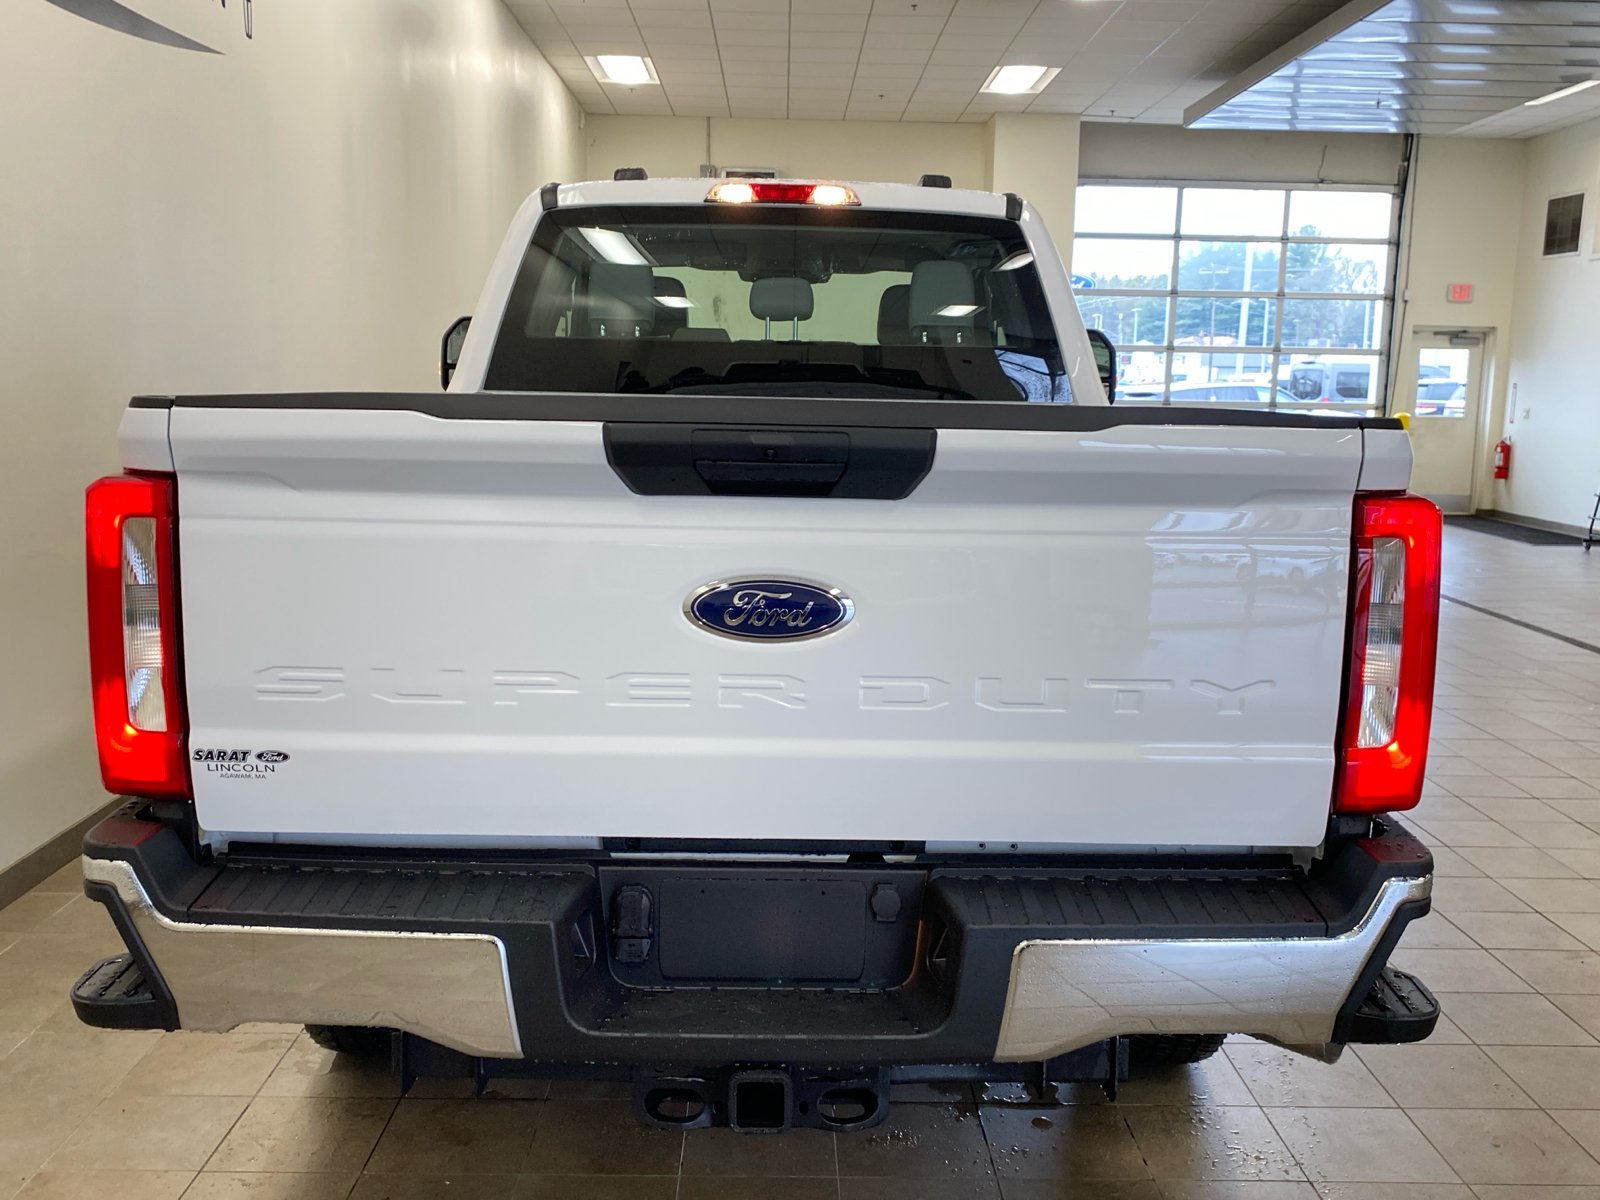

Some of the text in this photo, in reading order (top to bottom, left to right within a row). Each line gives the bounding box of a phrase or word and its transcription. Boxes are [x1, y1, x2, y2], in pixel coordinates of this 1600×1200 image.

[723, 589, 815, 627] Ford
[255, 665, 1277, 716] SUPER DUTY
[192, 748, 284, 763] SARAT Ford
[206, 763, 276, 773] LINCOLN
